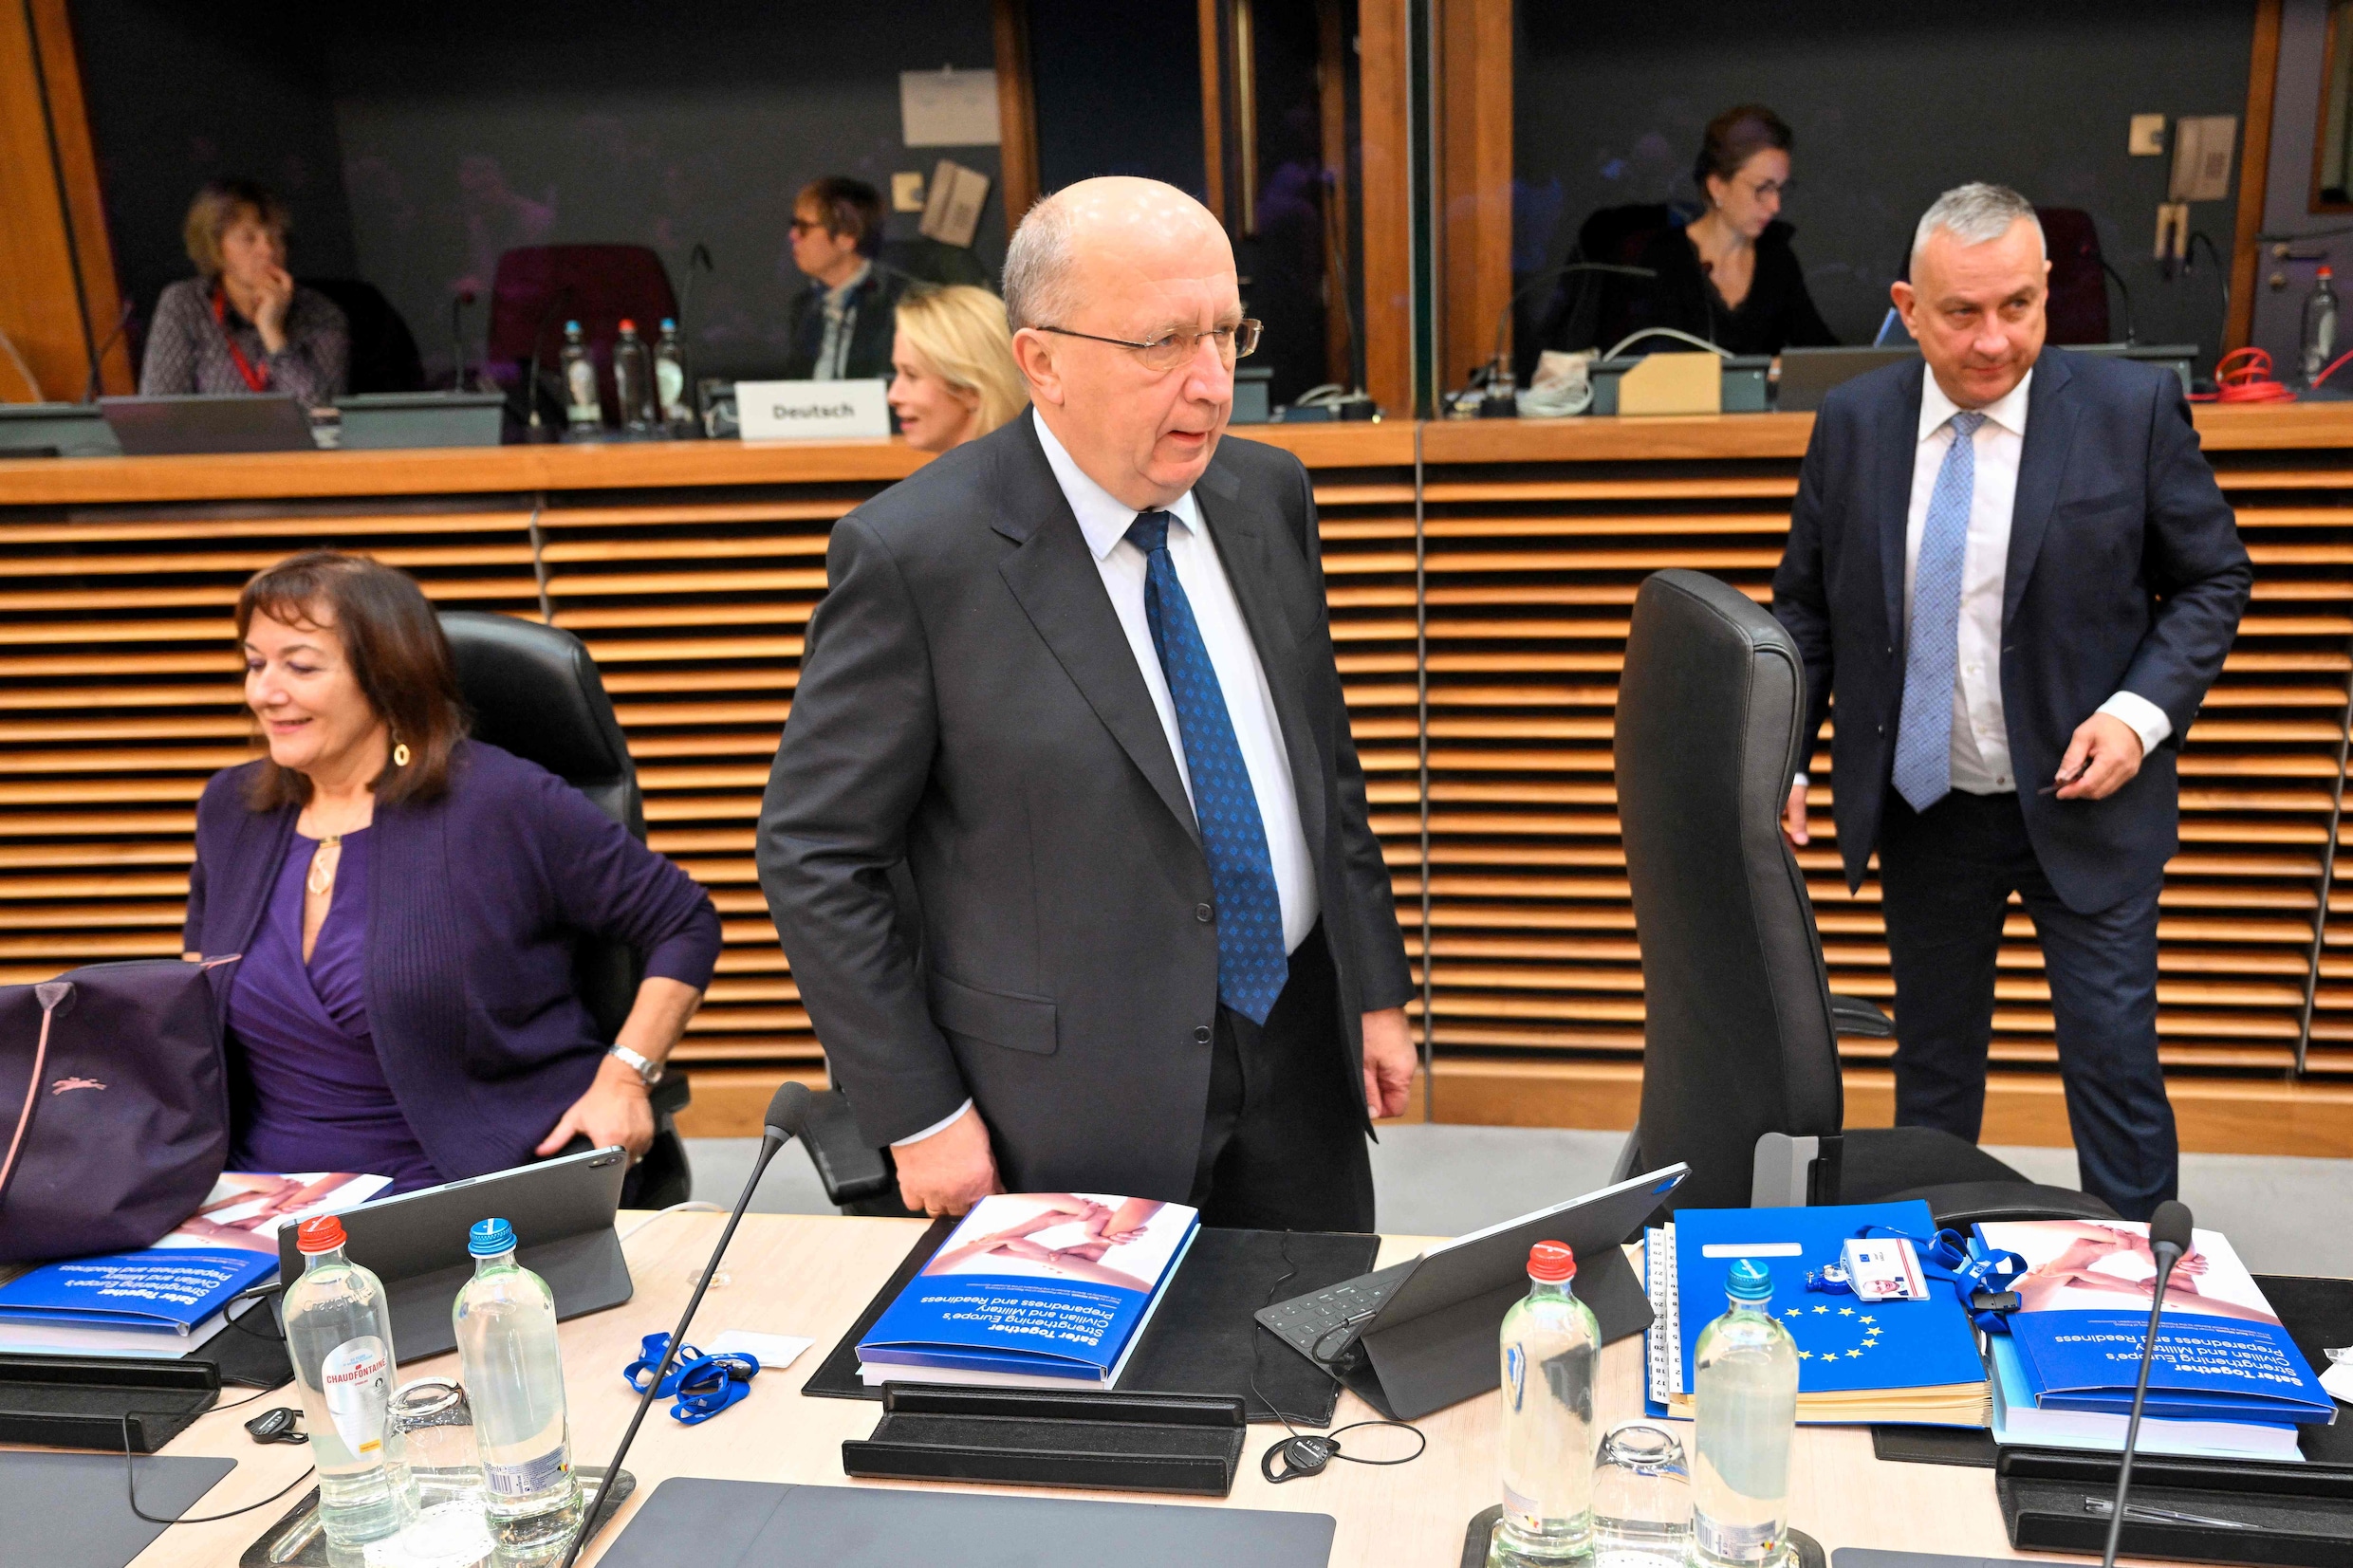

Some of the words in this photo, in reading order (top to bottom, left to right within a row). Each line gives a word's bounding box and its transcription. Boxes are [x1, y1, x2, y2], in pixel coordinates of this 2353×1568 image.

[772, 401, 855, 419] Deutsch
[97, 1288, 158, 1301] Together
[158, 1292, 198, 1306] Safer
[920, 1296, 990, 1305] Readiness
[991, 1297, 1019, 1307] and
[975, 1303, 1027, 1317] Military
[1022, 1299, 1115, 1319] Preparedness
[1028, 1309, 1057, 1320] and
[942, 1311, 1002, 1324] Europe's
[1059, 1312, 1109, 1329] Civilian
[988, 1323, 1056, 1339] Together
[1005, 1315, 1104, 1337] Strengthening
[1058, 1331, 1100, 1347] Safer
[2054, 1334, 2138, 1344] Readiness
[2173, 1335, 2285, 1357] Preparedness
[2135, 1342, 2193, 1356] Militay
[2196, 1346, 2228, 1357] and
[2177, 1353, 2297, 1377] Strengthening
[2231, 1350, 2290, 1367] Civilian
[326, 1357, 387, 1384] CHAUDFONTAINE
[2174, 1362, 2256, 1379] Together
[2256, 1372, 2304, 1387] Safer
